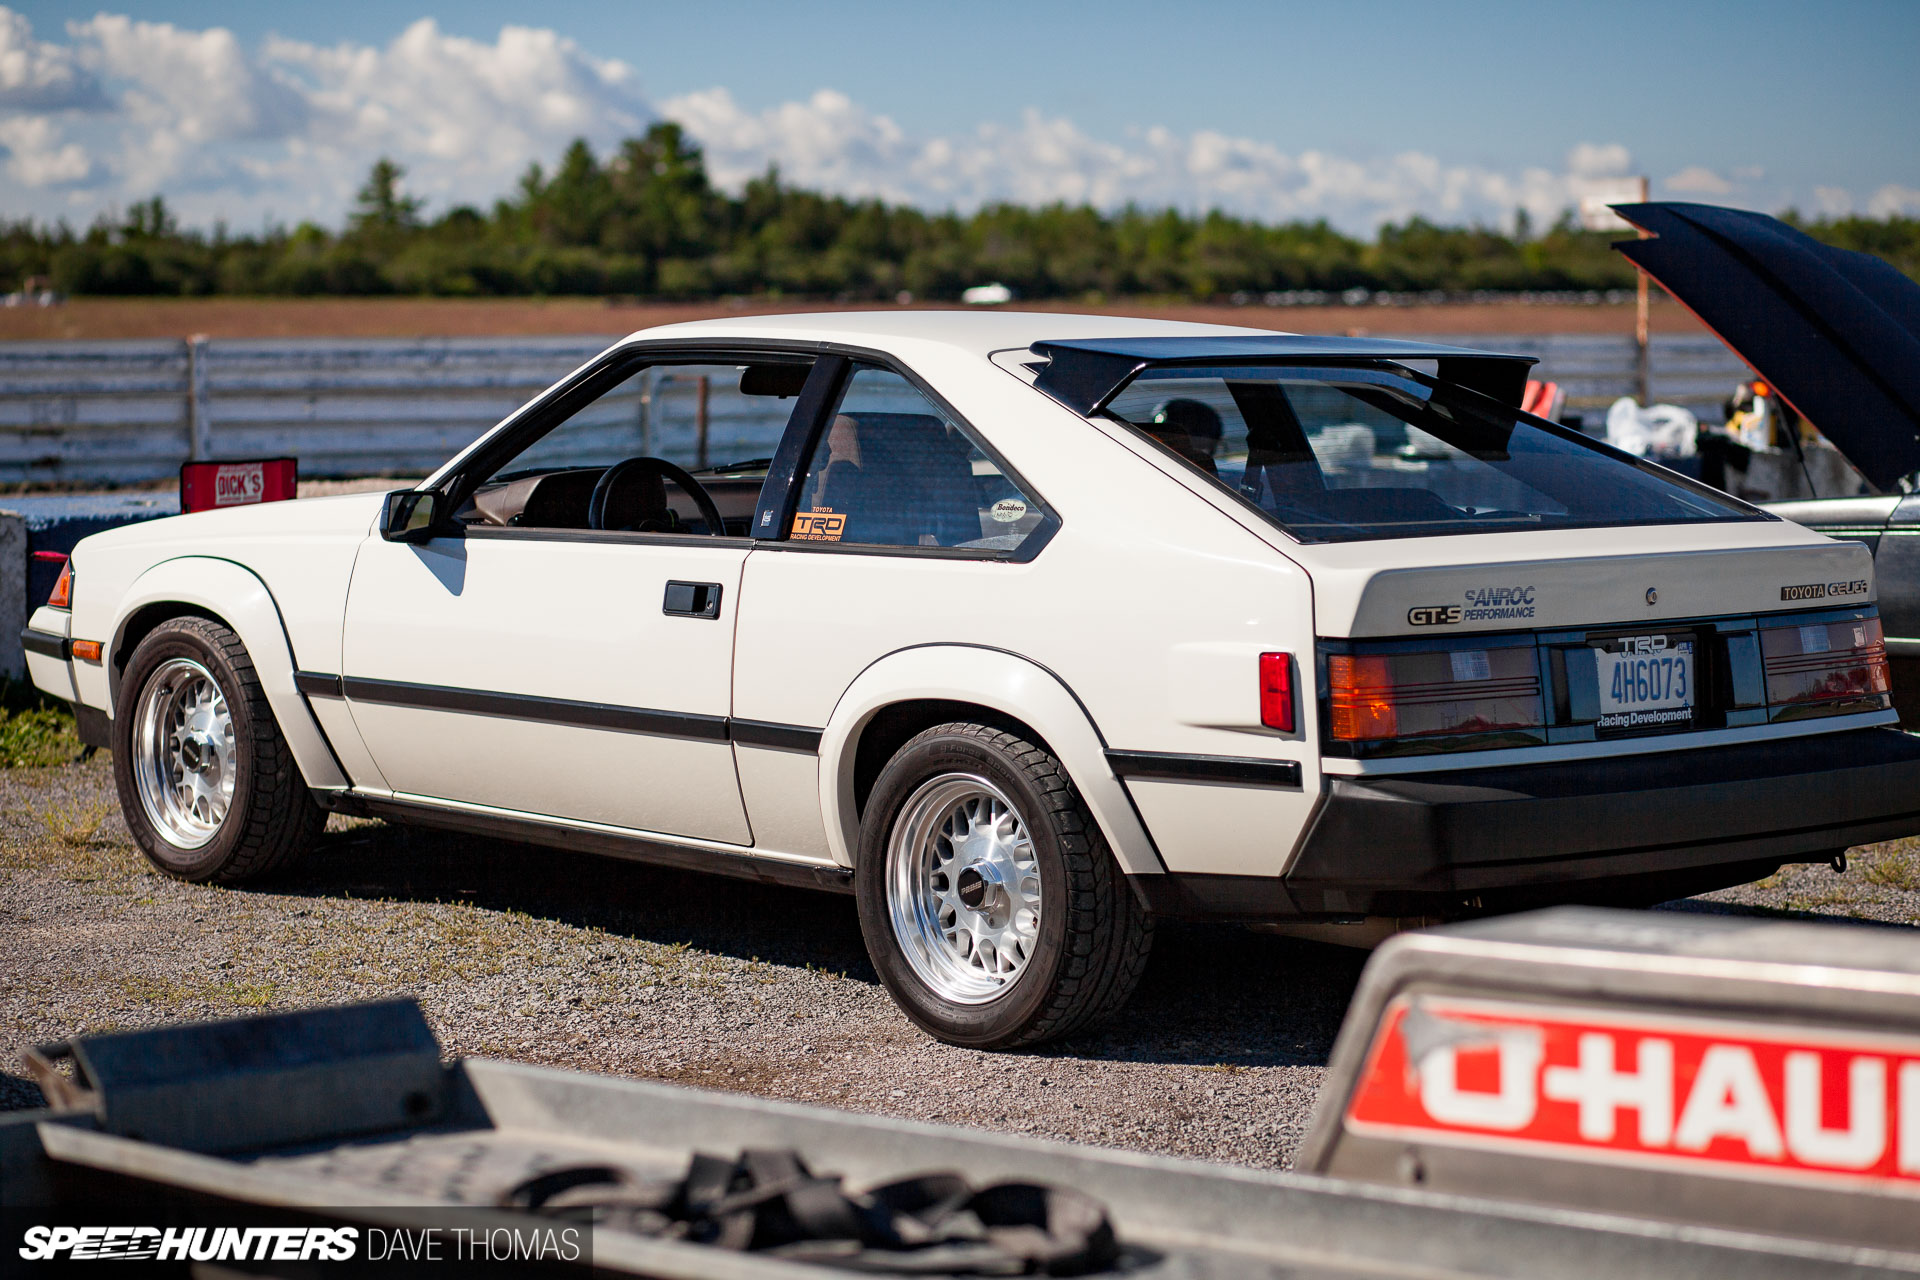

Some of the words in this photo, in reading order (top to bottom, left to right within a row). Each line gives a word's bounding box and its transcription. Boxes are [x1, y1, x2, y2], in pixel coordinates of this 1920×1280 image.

[218, 474, 261, 495] DICK'S
[797, 517, 842, 535] TRD
[1464, 586, 1536, 607] SANROC
[1784, 585, 1825, 599] TOYOTA
[1409, 607, 1462, 625] GT-S
[1463, 606, 1535, 621] PERFORMANCE
[1618, 635, 1668, 654] TRD
[1611, 657, 1687, 704] 4H6073
[1597, 714, 1630, 727] Racing
[1630, 708, 1692, 724] Development
[1420, 1028, 1920, 1174] U-HAU
